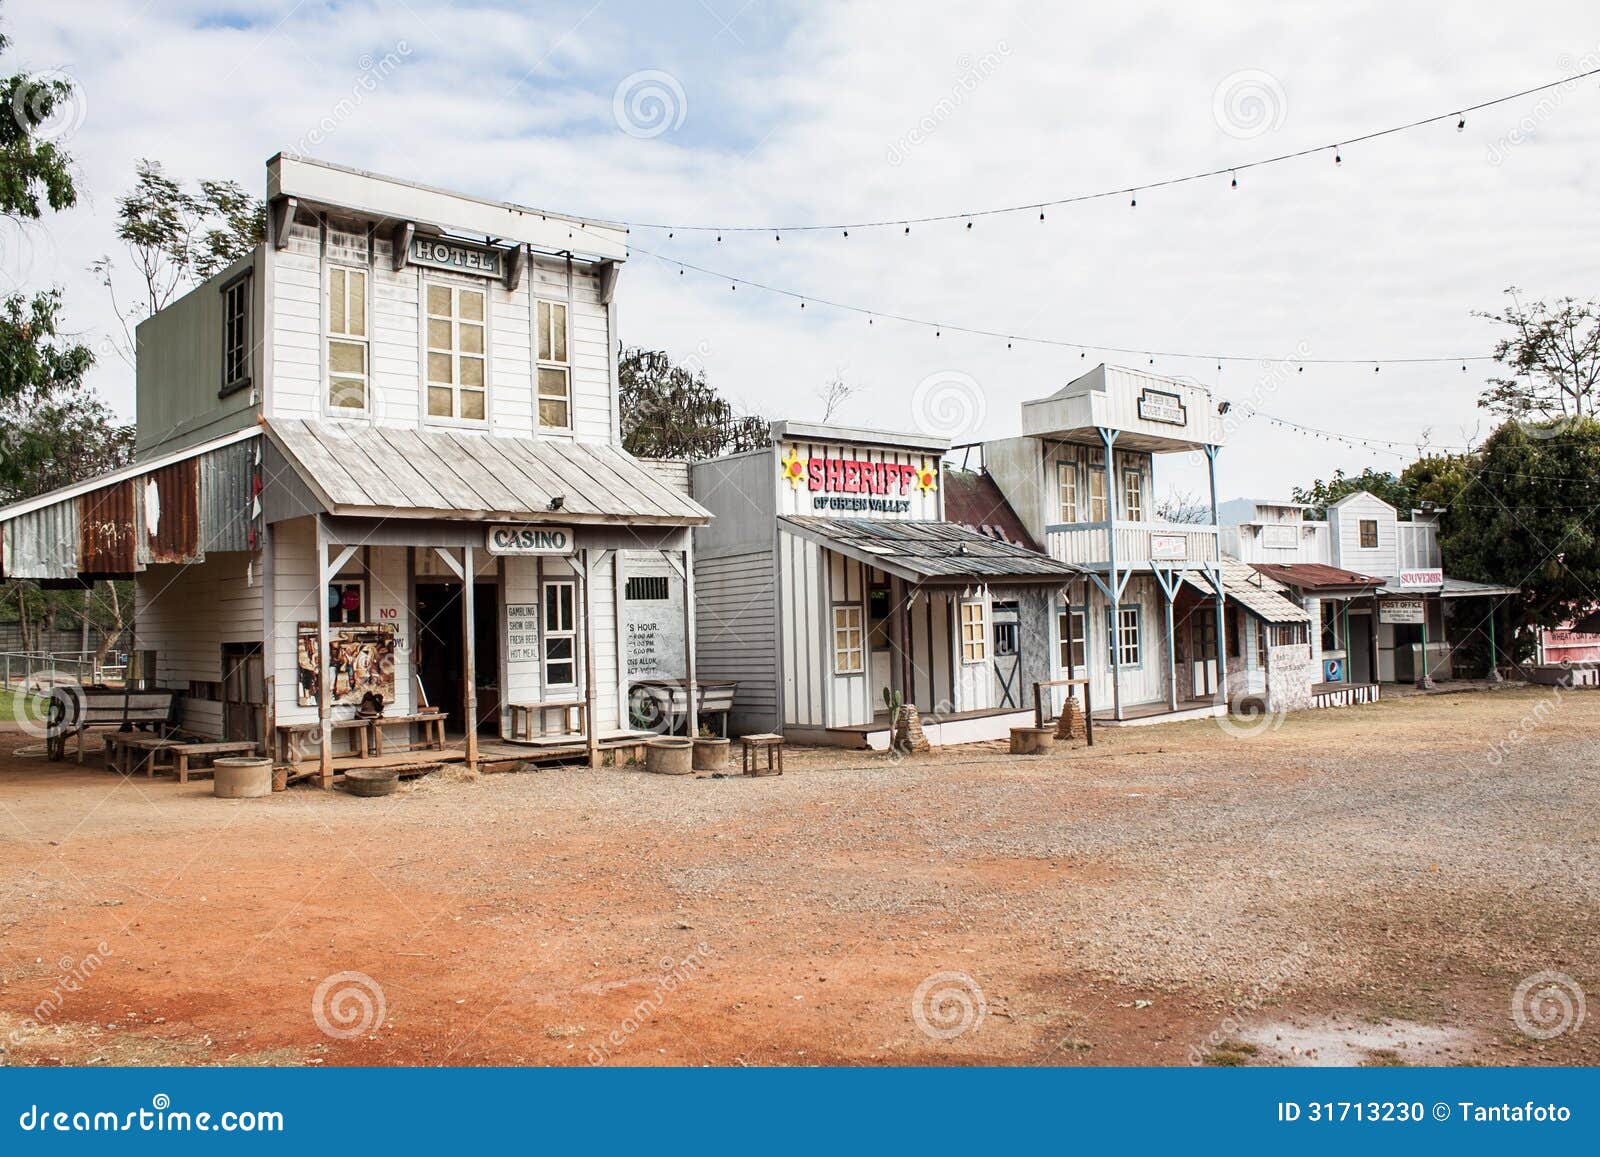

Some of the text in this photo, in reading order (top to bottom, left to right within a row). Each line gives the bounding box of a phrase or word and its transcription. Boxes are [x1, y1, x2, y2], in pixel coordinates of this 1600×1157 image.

[416, 240, 493, 271] HOTEL
[807, 458, 915, 496] SHERIFF
[814, 497, 910, 513] OF GREEN VALLEY
[494, 529, 567, 549] CASINO
[1401, 573, 1442, 583] SOUVENIR
[380, 609, 397, 618] NO
[508, 607, 535, 617] GAMBLING
[509, 620, 536, 630] SHOW GIRL
[510, 634, 537, 644] FRESH BEER
[510, 648, 537, 658] HOT MEAL
